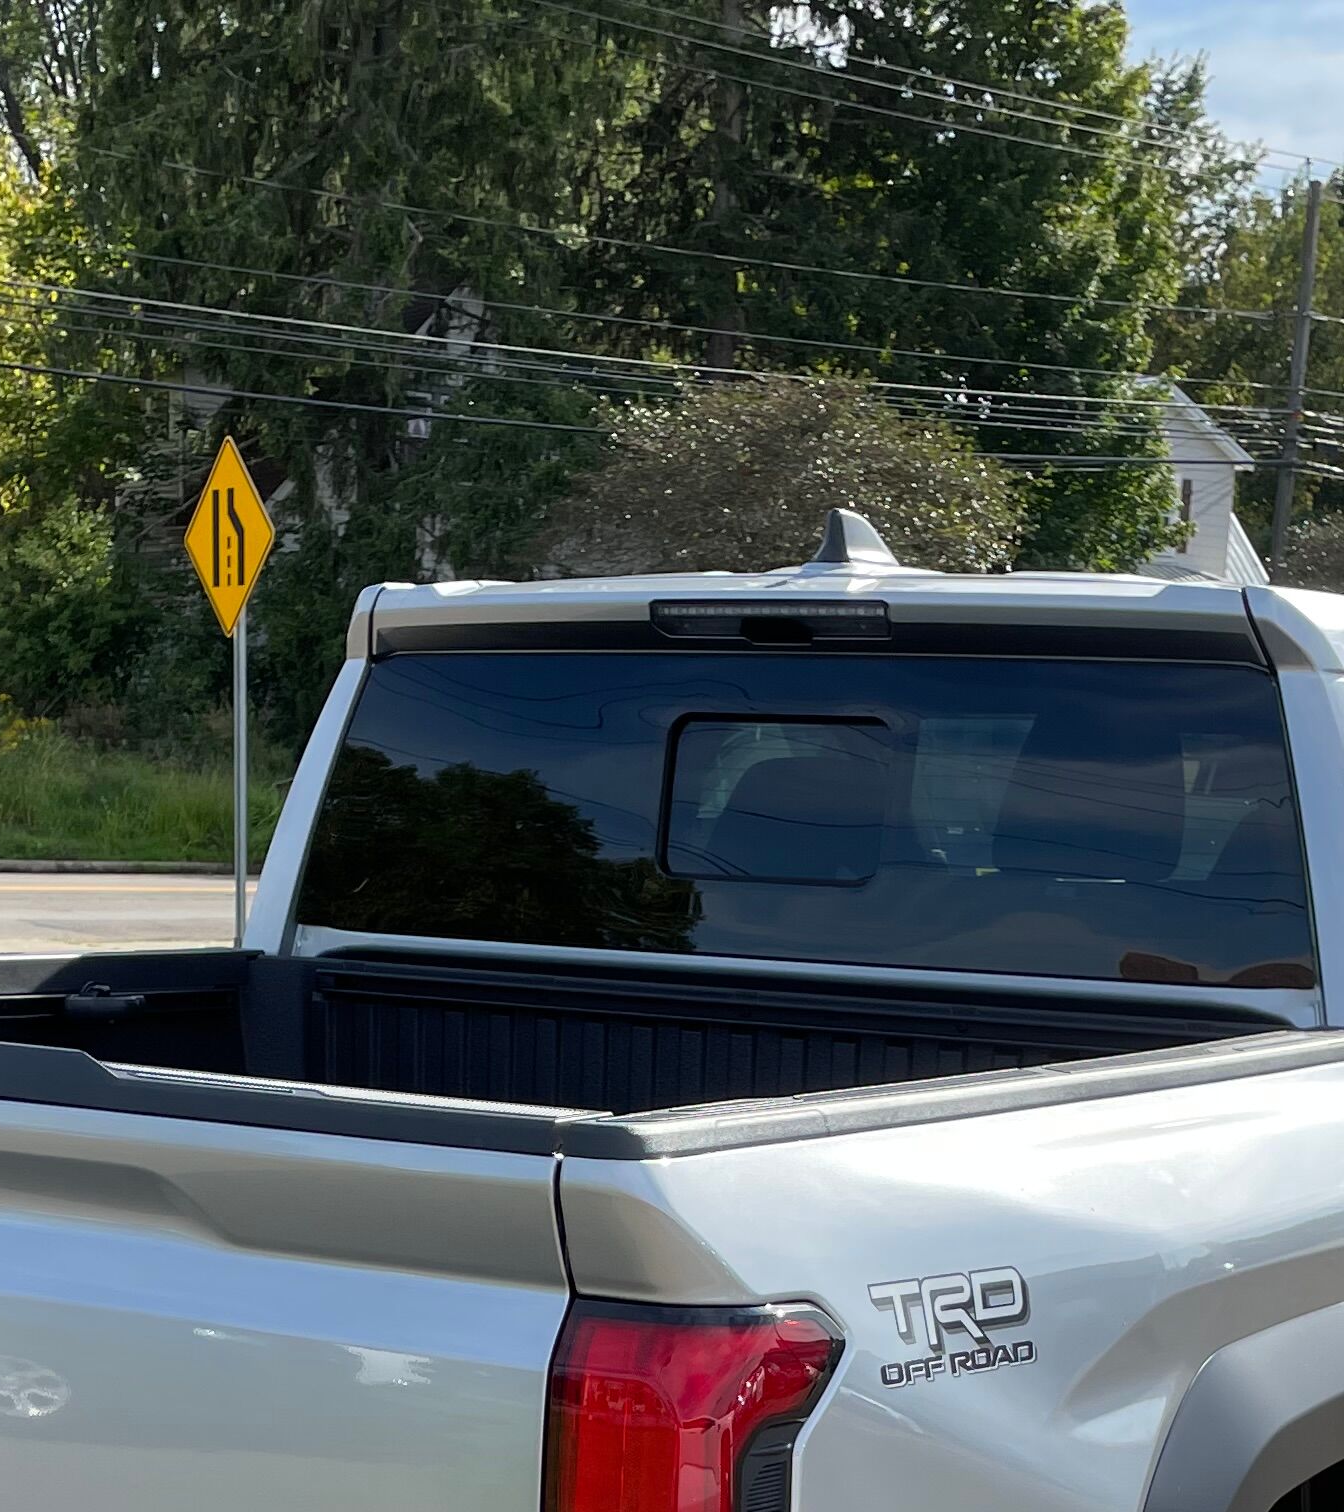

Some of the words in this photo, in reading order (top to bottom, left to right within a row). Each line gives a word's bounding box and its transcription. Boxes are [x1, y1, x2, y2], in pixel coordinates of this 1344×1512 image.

[867, 1265, 1031, 1356] TRD
[880, 1355, 945, 1389] OFF
[949, 1340, 1037, 1377] ROAD
